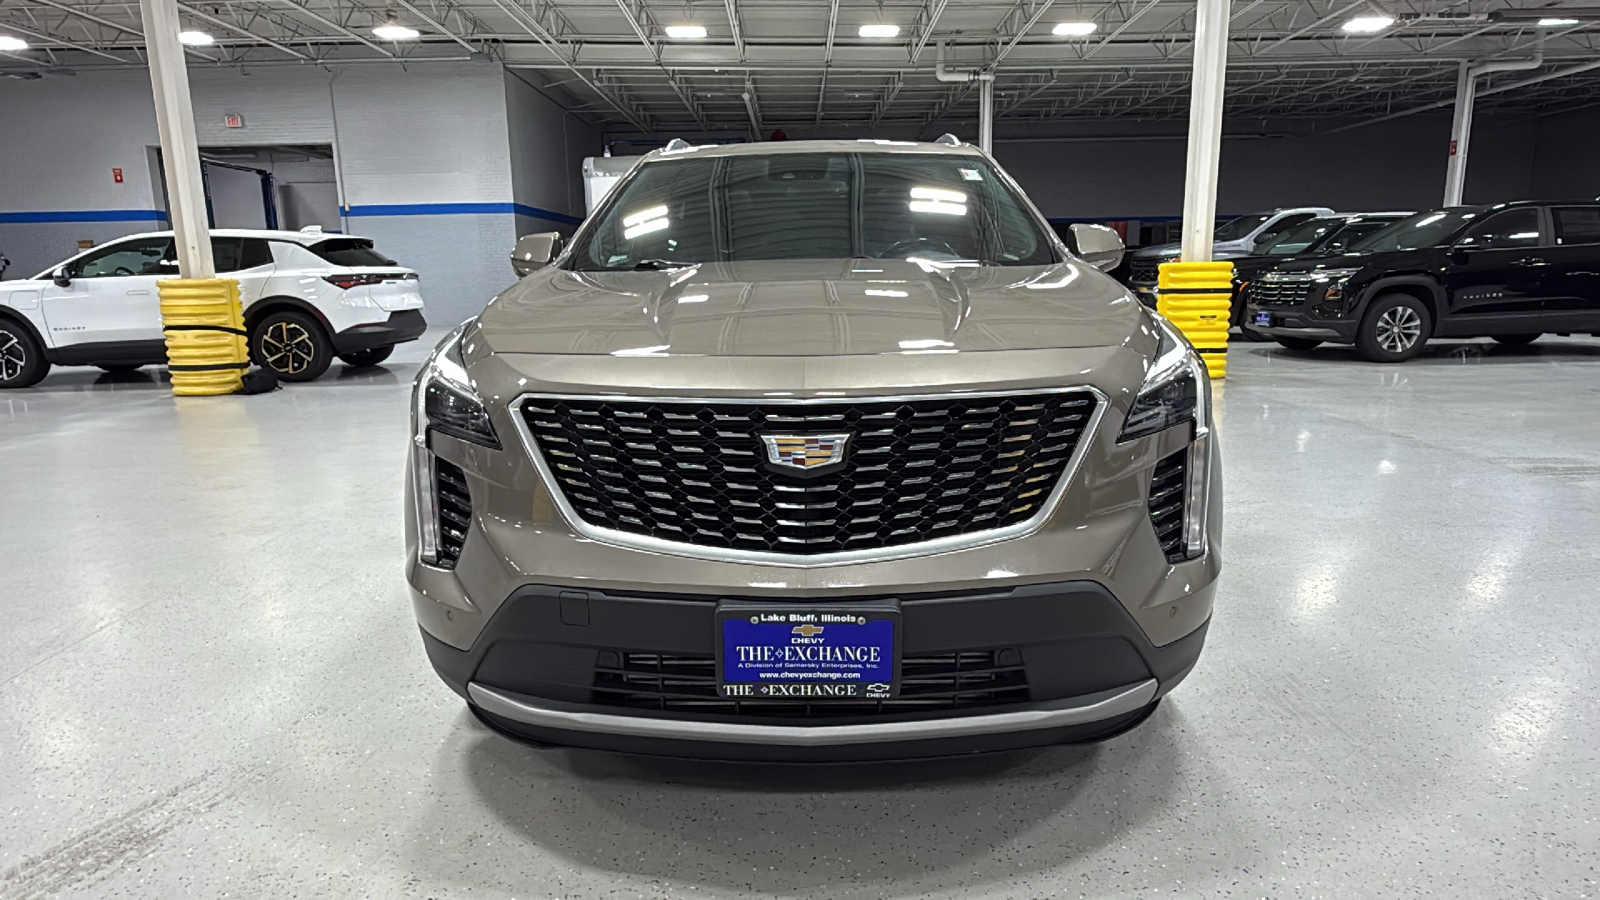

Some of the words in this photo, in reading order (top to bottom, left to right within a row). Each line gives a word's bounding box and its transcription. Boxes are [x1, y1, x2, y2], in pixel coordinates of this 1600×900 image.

[760, 613, 786, 622] Lake
[789, 613, 818, 623] Bluff,
[821, 614, 856, 623] Illinois
[736, 646, 775, 662] THE
[784, 646, 880, 662] EXCHANGE
[759, 671, 861, 680] www.chevyexchange.com
[723, 684, 754, 696] THE
[769, 684, 857, 696] EXCHANGE
